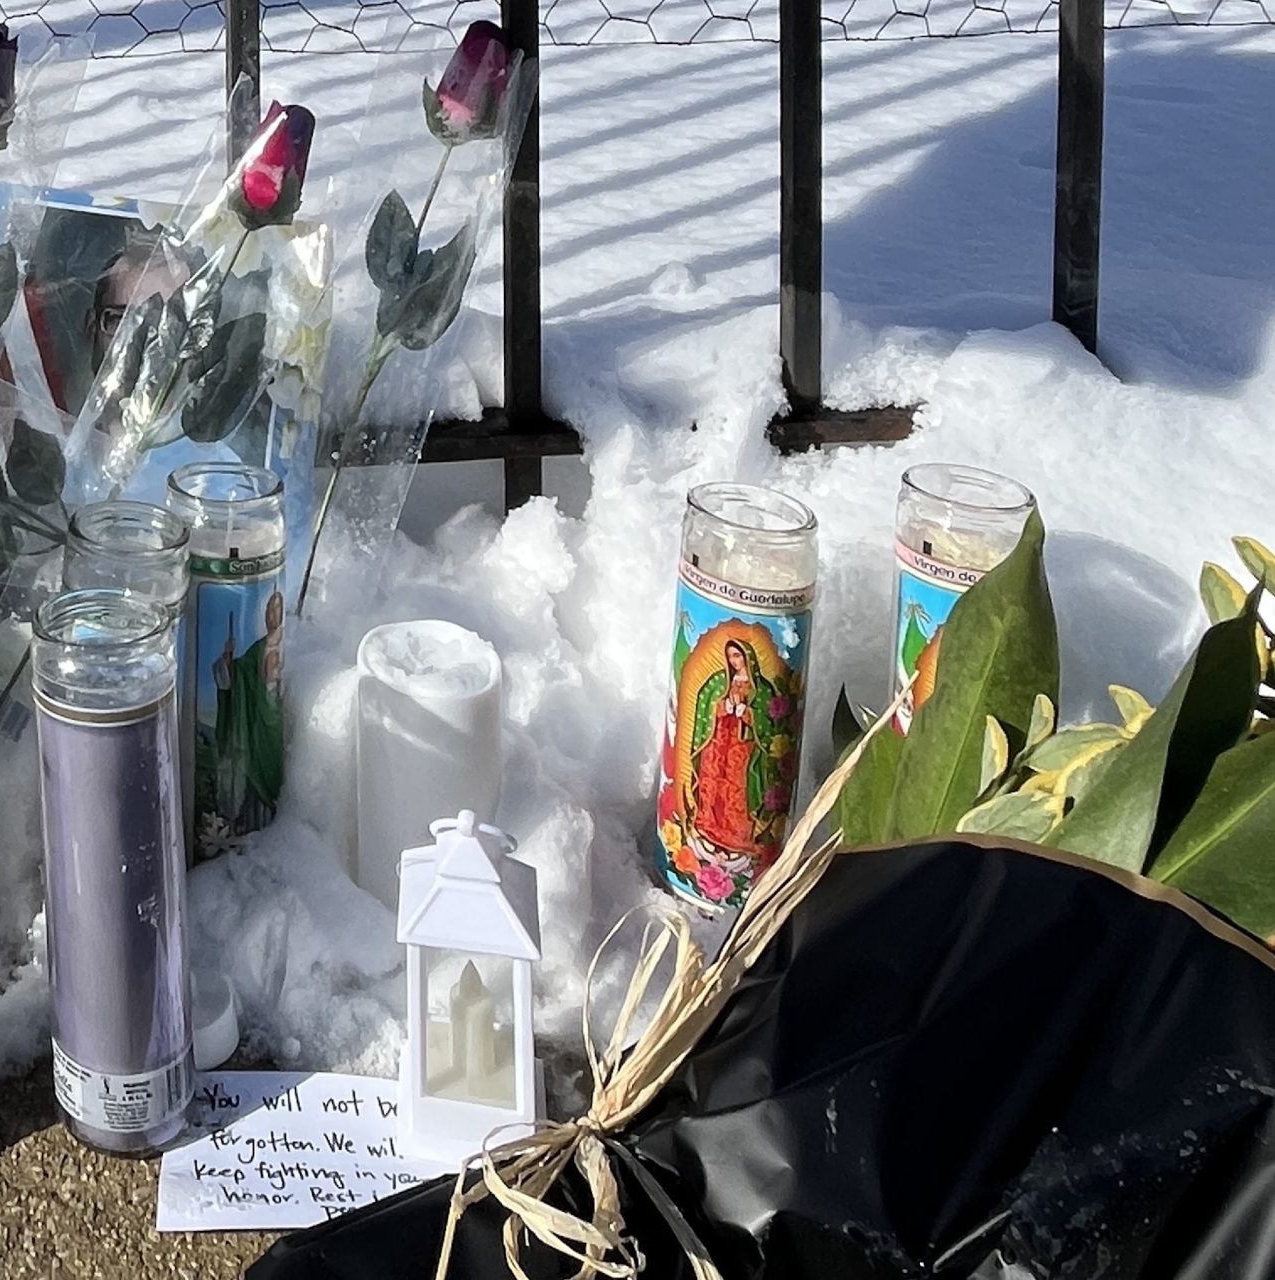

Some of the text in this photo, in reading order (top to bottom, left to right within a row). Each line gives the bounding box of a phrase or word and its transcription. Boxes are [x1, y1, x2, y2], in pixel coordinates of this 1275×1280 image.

[913, 555, 977, 583] Virgen de
[685, 564, 806, 607] Virgen de Guadalupe
[203, 1083, 241, 1112] You
[262, 1084, 303, 1113] will
[322, 1089, 365, 1117] not
[323, 1131, 357, 1154] We
[367, 1136, 405, 1160] wil
[254, 1160, 346, 1191] fighting
[354, 1163, 377, 1180] in
[383, 1170, 424, 1191] you
[220, 1183, 300, 1206] honor.
[309, 1185, 363, 1203] Rest
